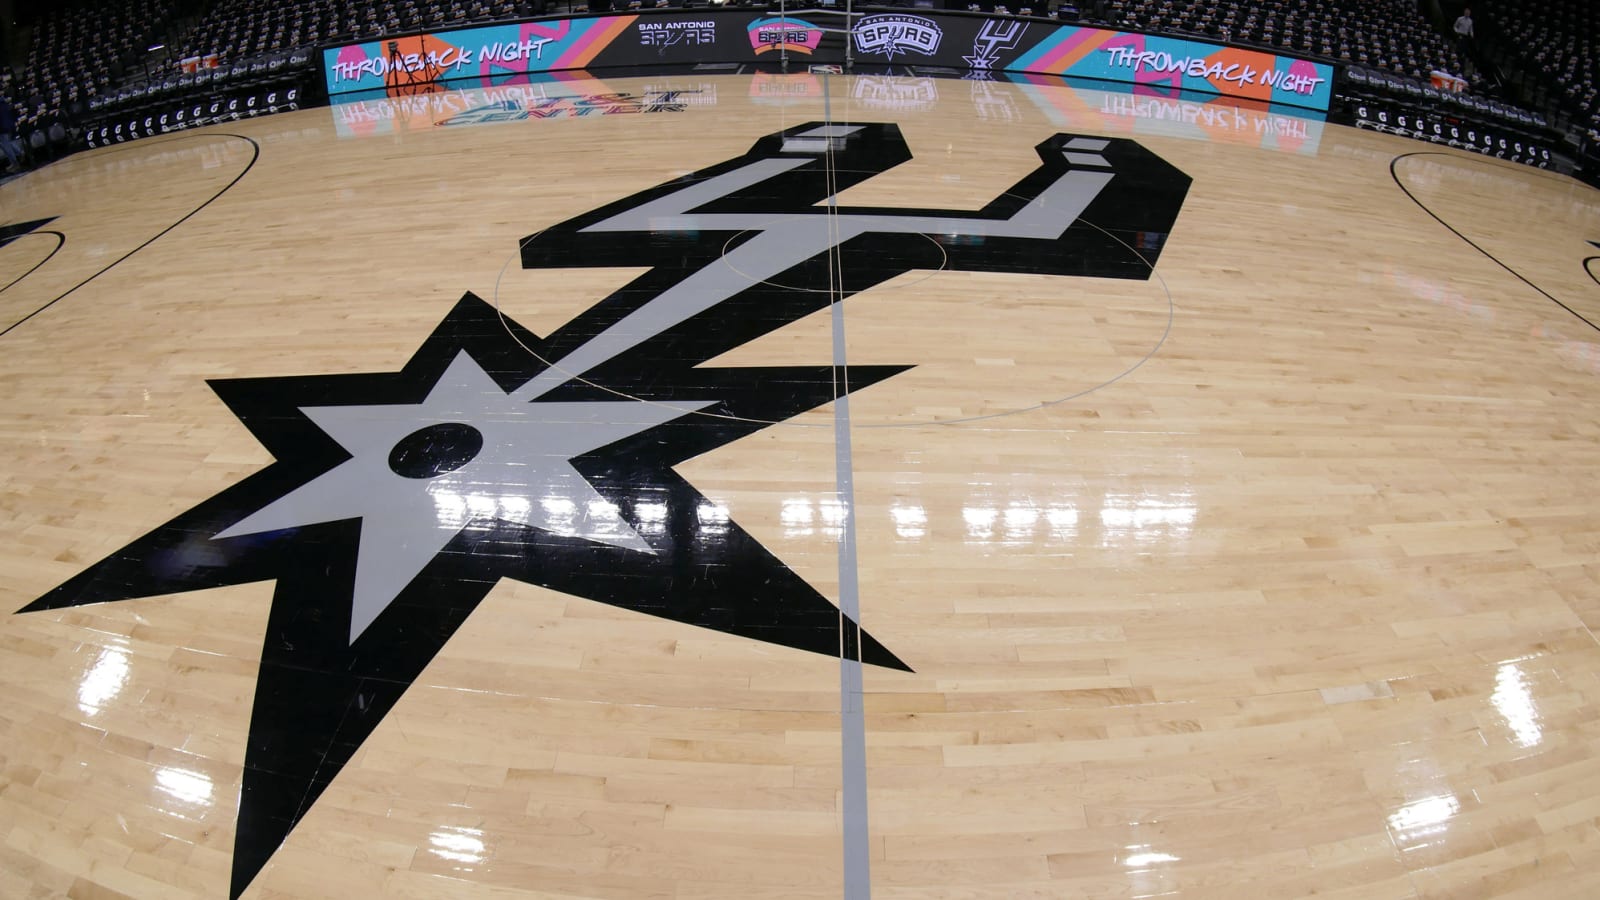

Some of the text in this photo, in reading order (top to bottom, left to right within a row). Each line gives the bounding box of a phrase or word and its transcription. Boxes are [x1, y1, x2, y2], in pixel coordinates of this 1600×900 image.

[638, 21, 716, 31] SAN ANTONIO
[888, 17, 930, 27] ANTONIO
[862, 26, 932, 46] SPURS
[331, 38, 554, 83] THROWBACK NIGHT
[1107, 47, 1325, 96] THROWBACK NIGHT
[267, 93, 277, 104] G
[287, 90, 297, 101] G
[229, 100, 238, 110] G
[247, 97, 256, 107] G
[193, 107, 202, 117] G
[210, 104, 219, 113] G
[1358, 108, 1368, 118] G
[160, 115, 168, 125] G
[176, 111, 184, 121] G
[1378, 112, 1387, 122] G
[129, 122, 137, 131] G
[144, 118, 153, 128] G
[1397, 117, 1406, 127] G
[1415, 120, 1424, 130] G
[101, 128, 108, 137] G
[115, 125, 122, 134] G
[1433, 124, 1442, 134] G
[1450, 128, 1459, 138] G
[87, 132, 94, 141] G
[1467, 132, 1476, 142] G
[1484, 136, 1492, 146] G
[1499, 140, 1507, 149] G
[1514, 144, 1522, 153] G
[1528, 147, 1536, 156] G
[1542, 151, 1549, 160] G
